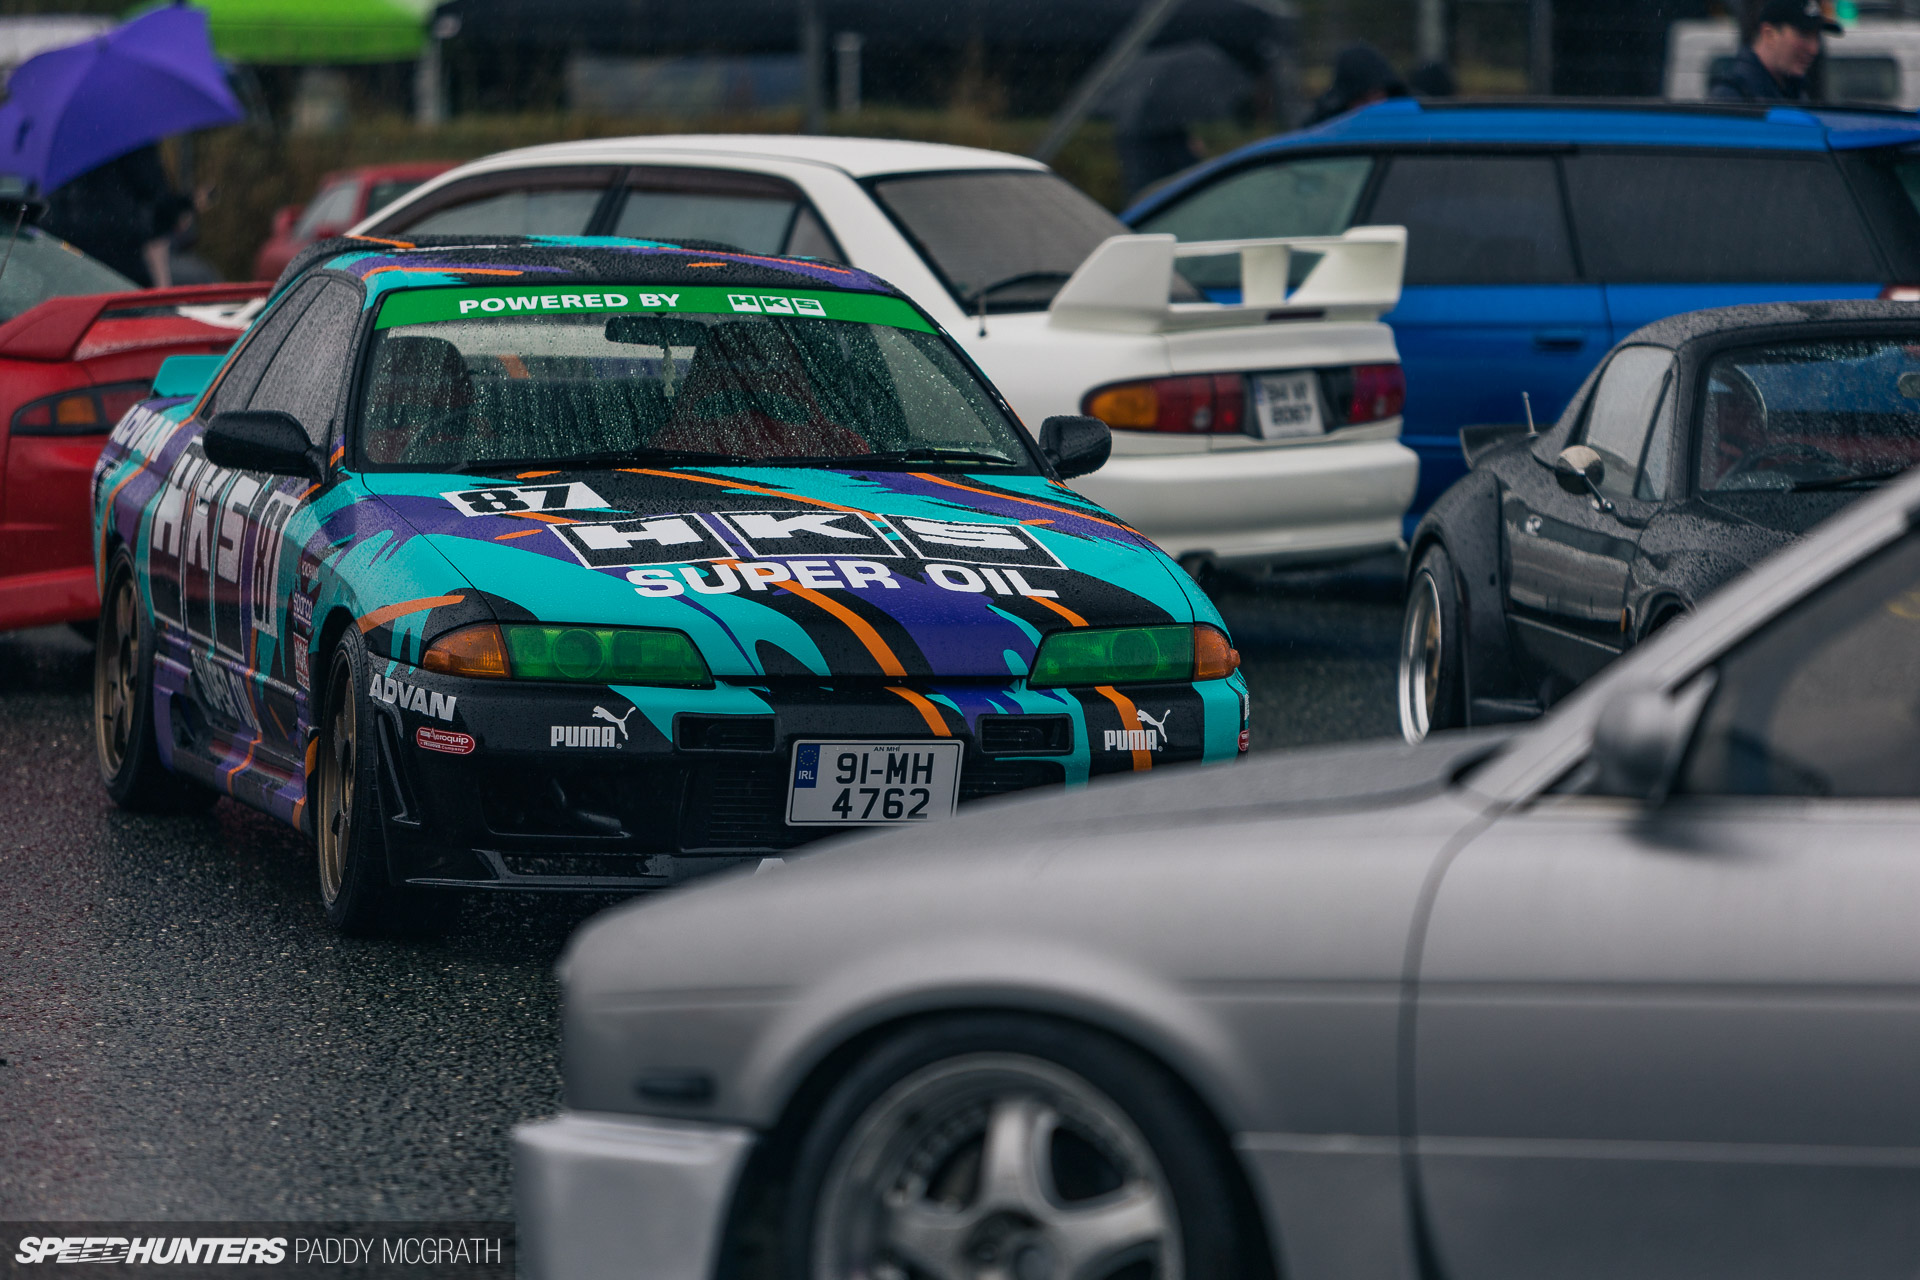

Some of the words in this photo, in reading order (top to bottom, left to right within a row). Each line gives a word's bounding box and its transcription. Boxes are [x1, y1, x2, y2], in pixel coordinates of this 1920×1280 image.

[459, 293, 629, 315] POWERED
[639, 293, 680, 309] BY
[727, 294, 826, 316] HKS
[110, 404, 180, 463] ADVAN
[457, 485, 571, 513] 87
[152, 453, 262, 584] HKS
[571, 514, 1029, 551] HKS
[626, 560, 901, 598] SUPER
[926, 563, 1059, 599] OIL
[368, 673, 457, 722] ADVAN
[430, 728, 470, 746] Aeroquip
[550, 725, 616, 748] PUMA
[1104, 729, 1158, 751] PUMA
[798, 770, 815, 780] IRL
[835, 753, 935, 785] 91-MH
[832, 788, 930, 820] 4762
